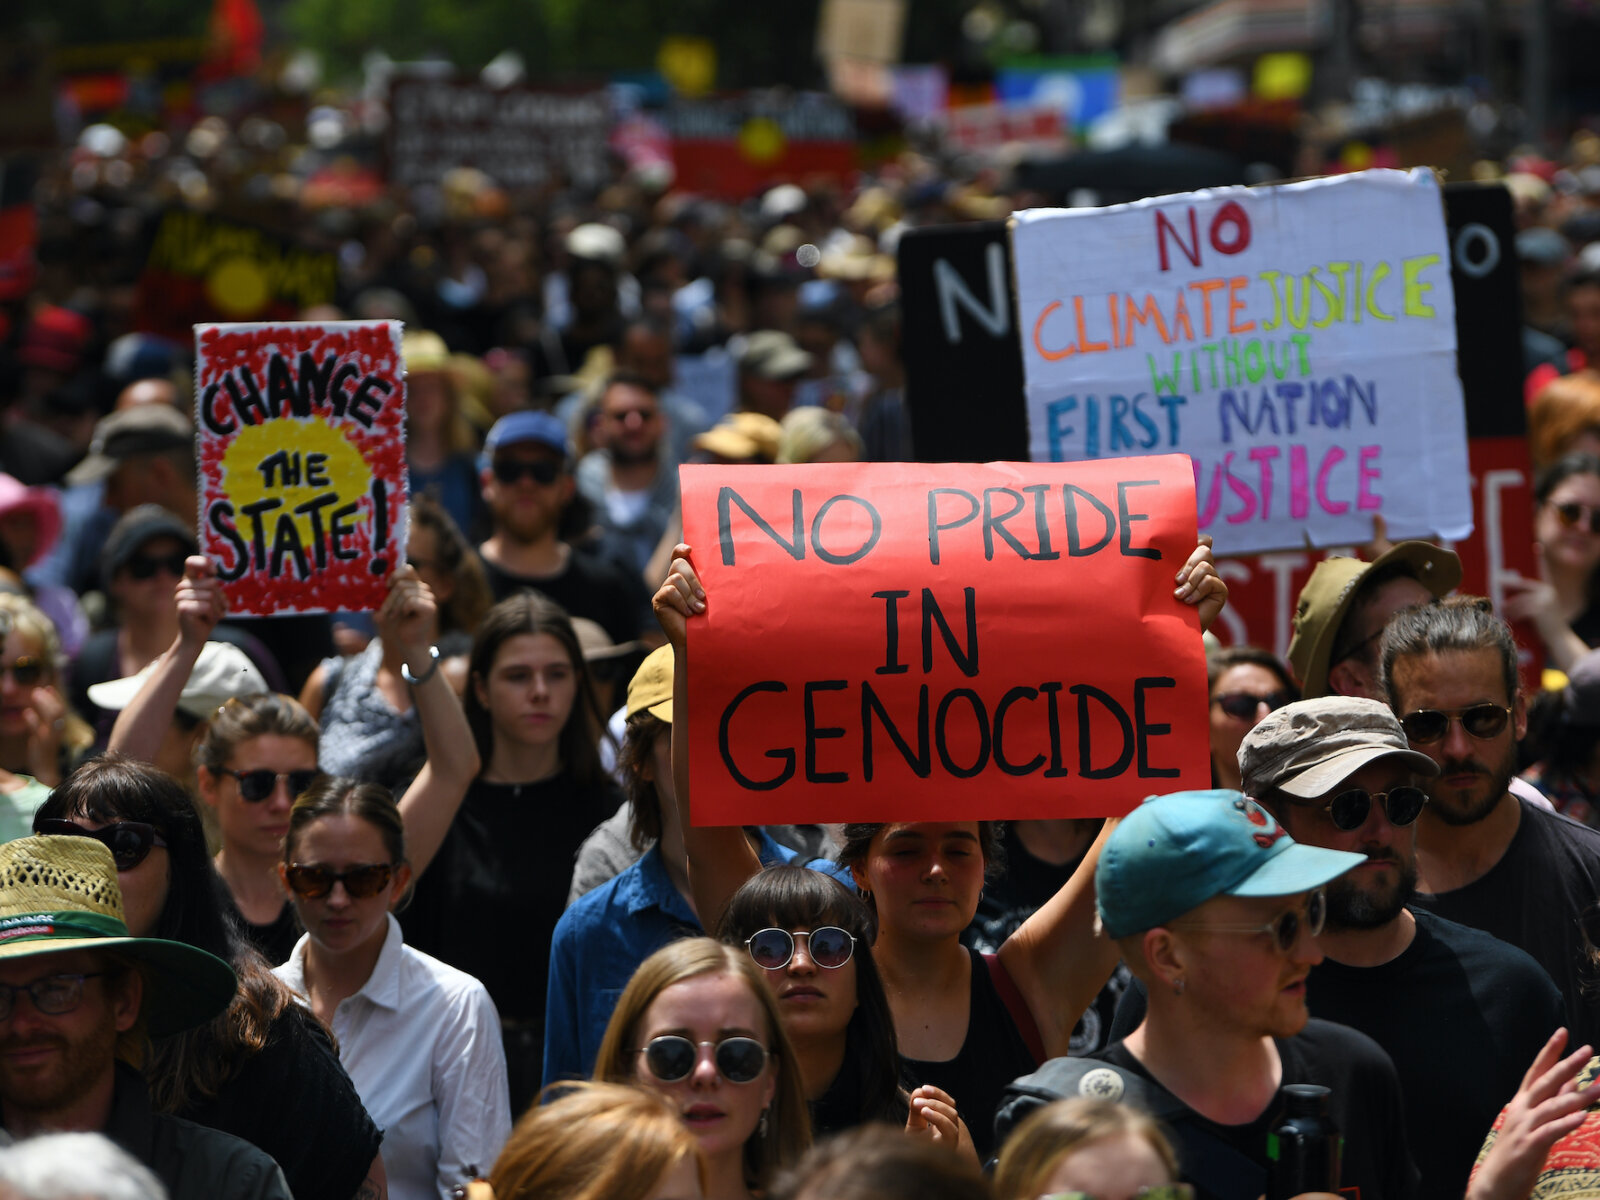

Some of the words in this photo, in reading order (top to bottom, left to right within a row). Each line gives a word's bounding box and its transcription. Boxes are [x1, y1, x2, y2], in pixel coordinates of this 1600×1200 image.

[1154, 200, 1253, 272] NO
[1033, 276, 1257, 361] CLIMATE
[1258, 253, 1441, 332] JUSTICE
[202, 350, 392, 436] CHANGE
[1147, 333, 1313, 397] WITHOUT
[1045, 392, 1188, 462] FIRST
[1218, 373, 1377, 445] NATION
[258, 450, 330, 488] THE
[1196, 444, 1384, 530] USTICE
[208, 477, 388, 582] STATE!
[717, 486, 882, 566] NO
[927, 479, 1162, 566] PRIDE
[871, 586, 979, 677] IN
[718, 675, 1181, 792] GENOCIDE
[0, 914, 55, 929] NNINGS
